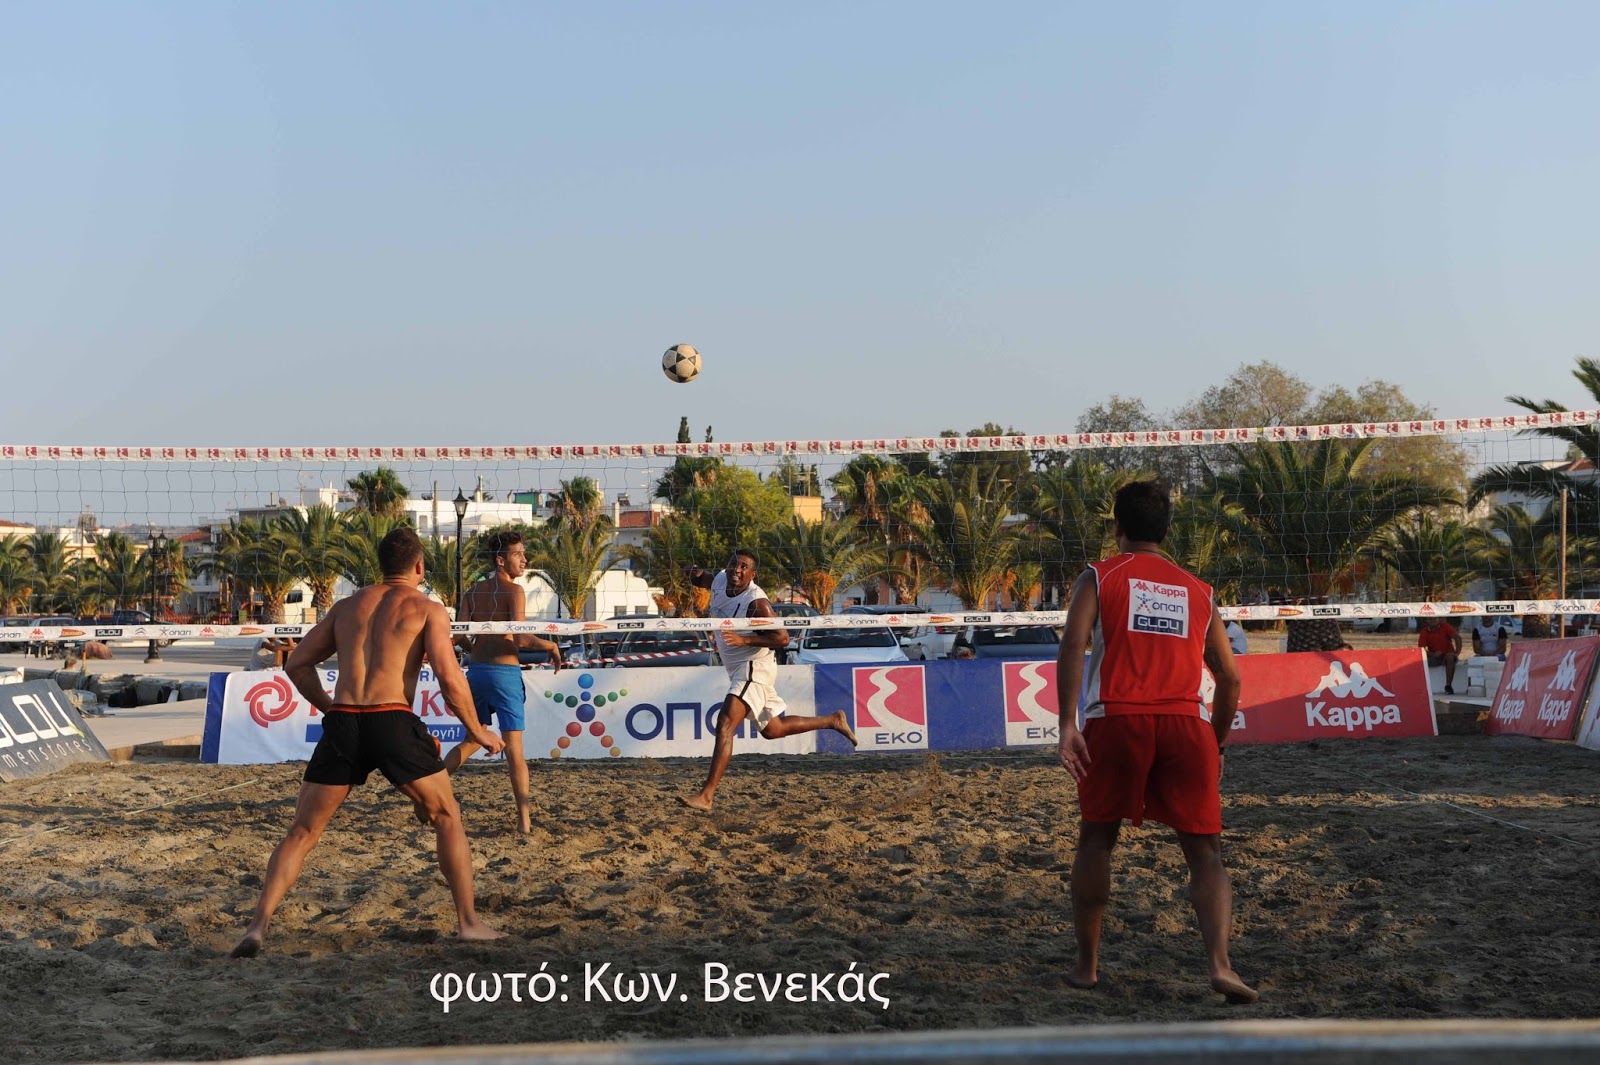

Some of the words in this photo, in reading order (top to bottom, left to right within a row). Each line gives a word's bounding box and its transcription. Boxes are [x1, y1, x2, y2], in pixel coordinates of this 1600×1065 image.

[1153, 584, 1187, 598] Kappa
[1137, 616, 1180, 631] GLOU
[1305, 701, 1402, 731] Kappa
[1495, 693, 1525, 725] Kappa
[1537, 693, 1572, 727] Kappa
[875, 731, 922, 744] EKO
[1026, 727, 1059, 739] EK
